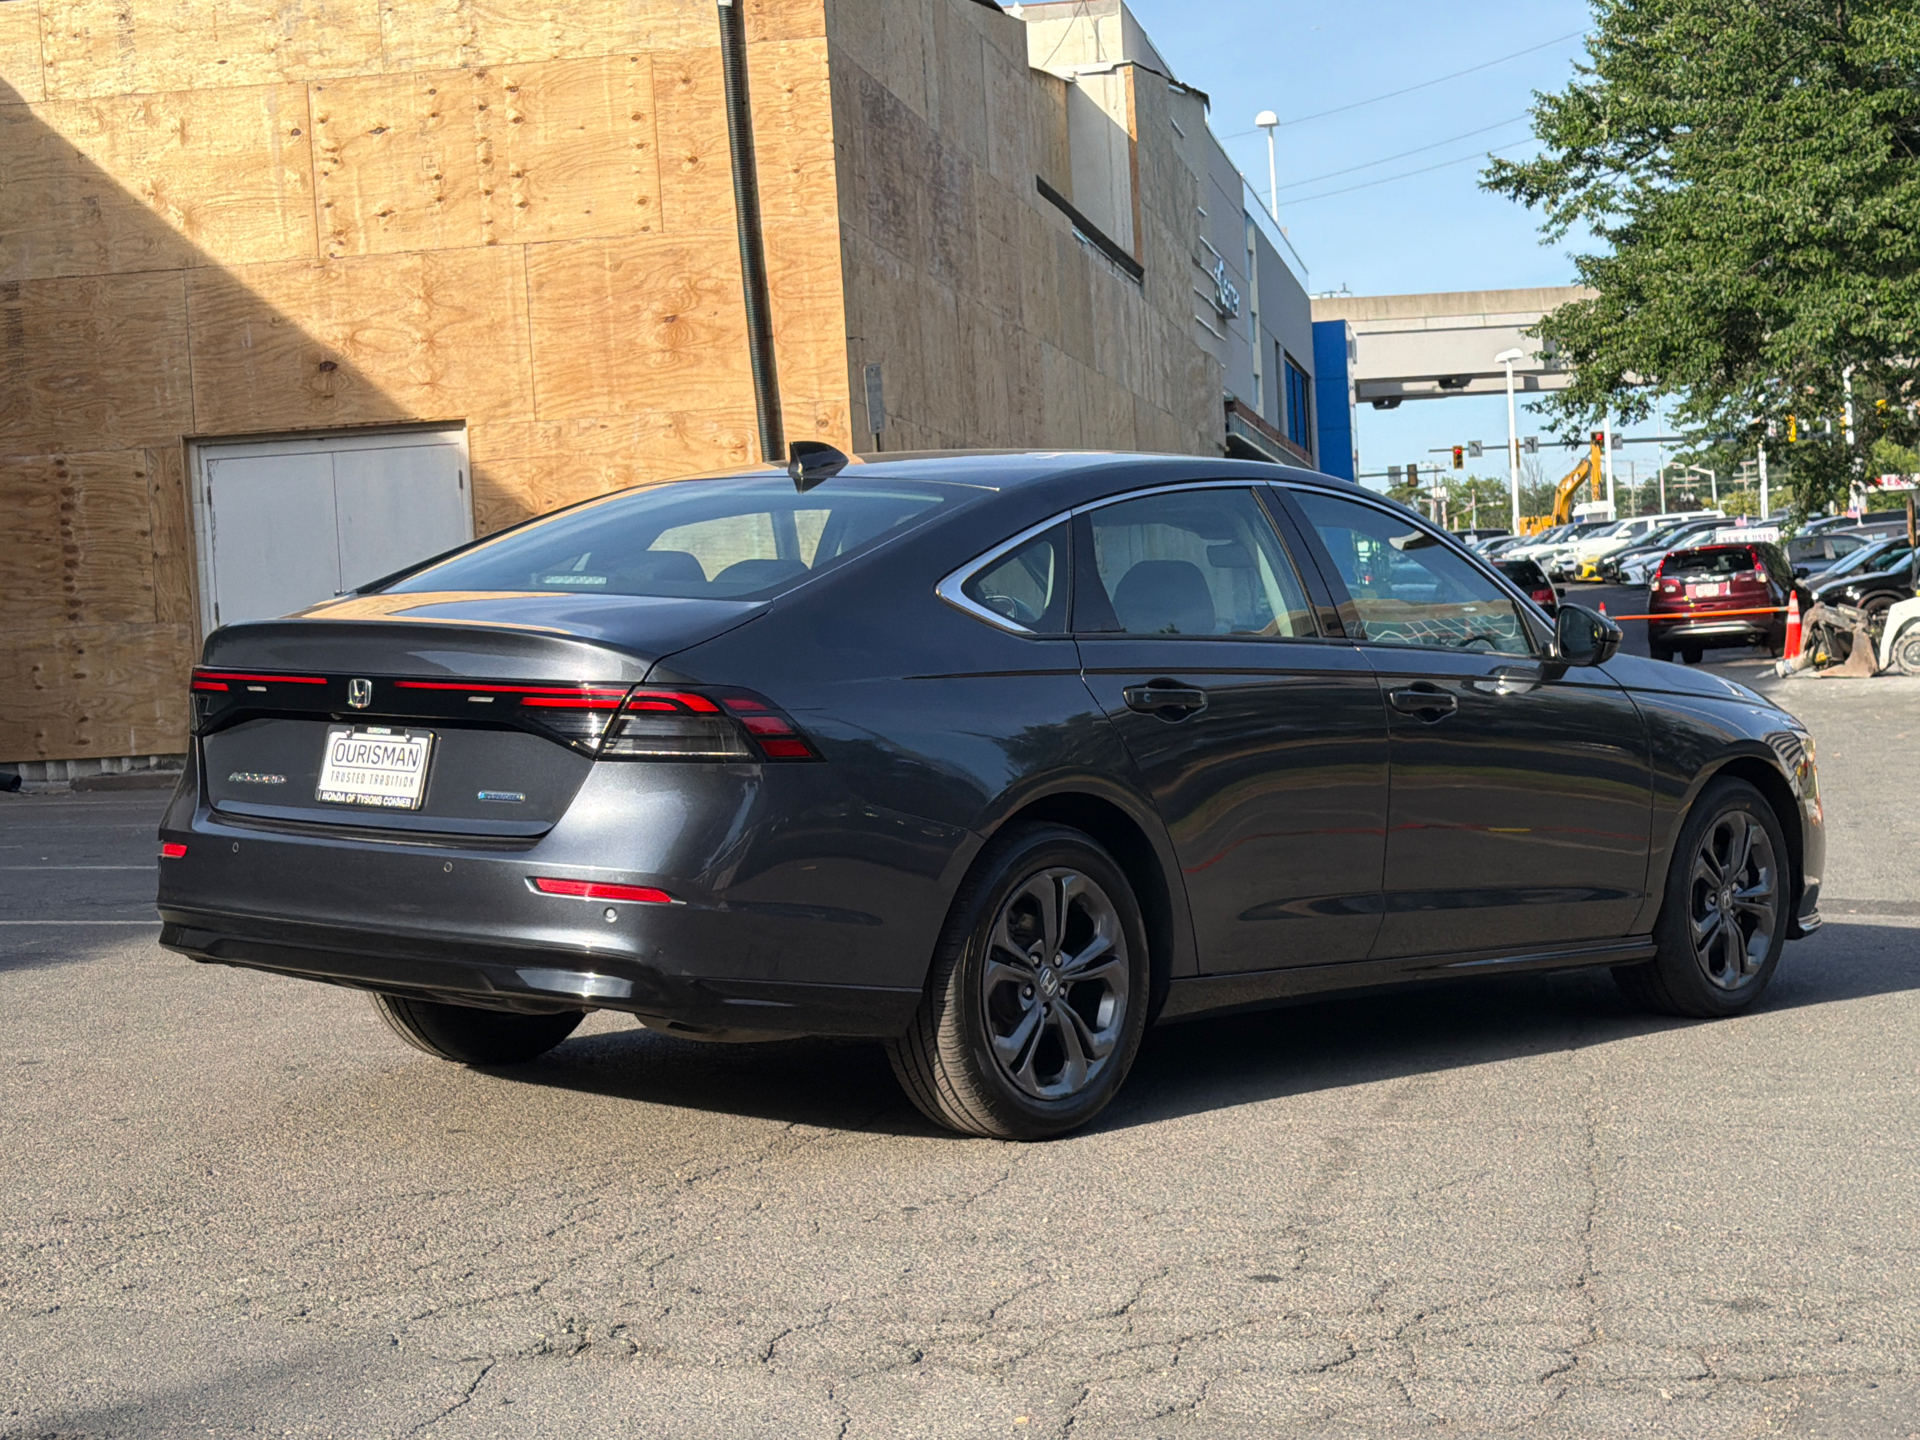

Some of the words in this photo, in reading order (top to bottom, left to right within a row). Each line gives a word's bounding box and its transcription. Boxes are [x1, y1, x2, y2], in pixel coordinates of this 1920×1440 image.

[335, 742, 419, 767] OURISMAN
[228, 771, 287, 784] ACCORD
[331, 770, 365, 785] TRUSTED
[322, 791, 345, 803] HONDA
[346, 794, 356, 803] OF
[357, 794, 383, 806] TYSONS
[383, 796, 411, 808] CORNER
